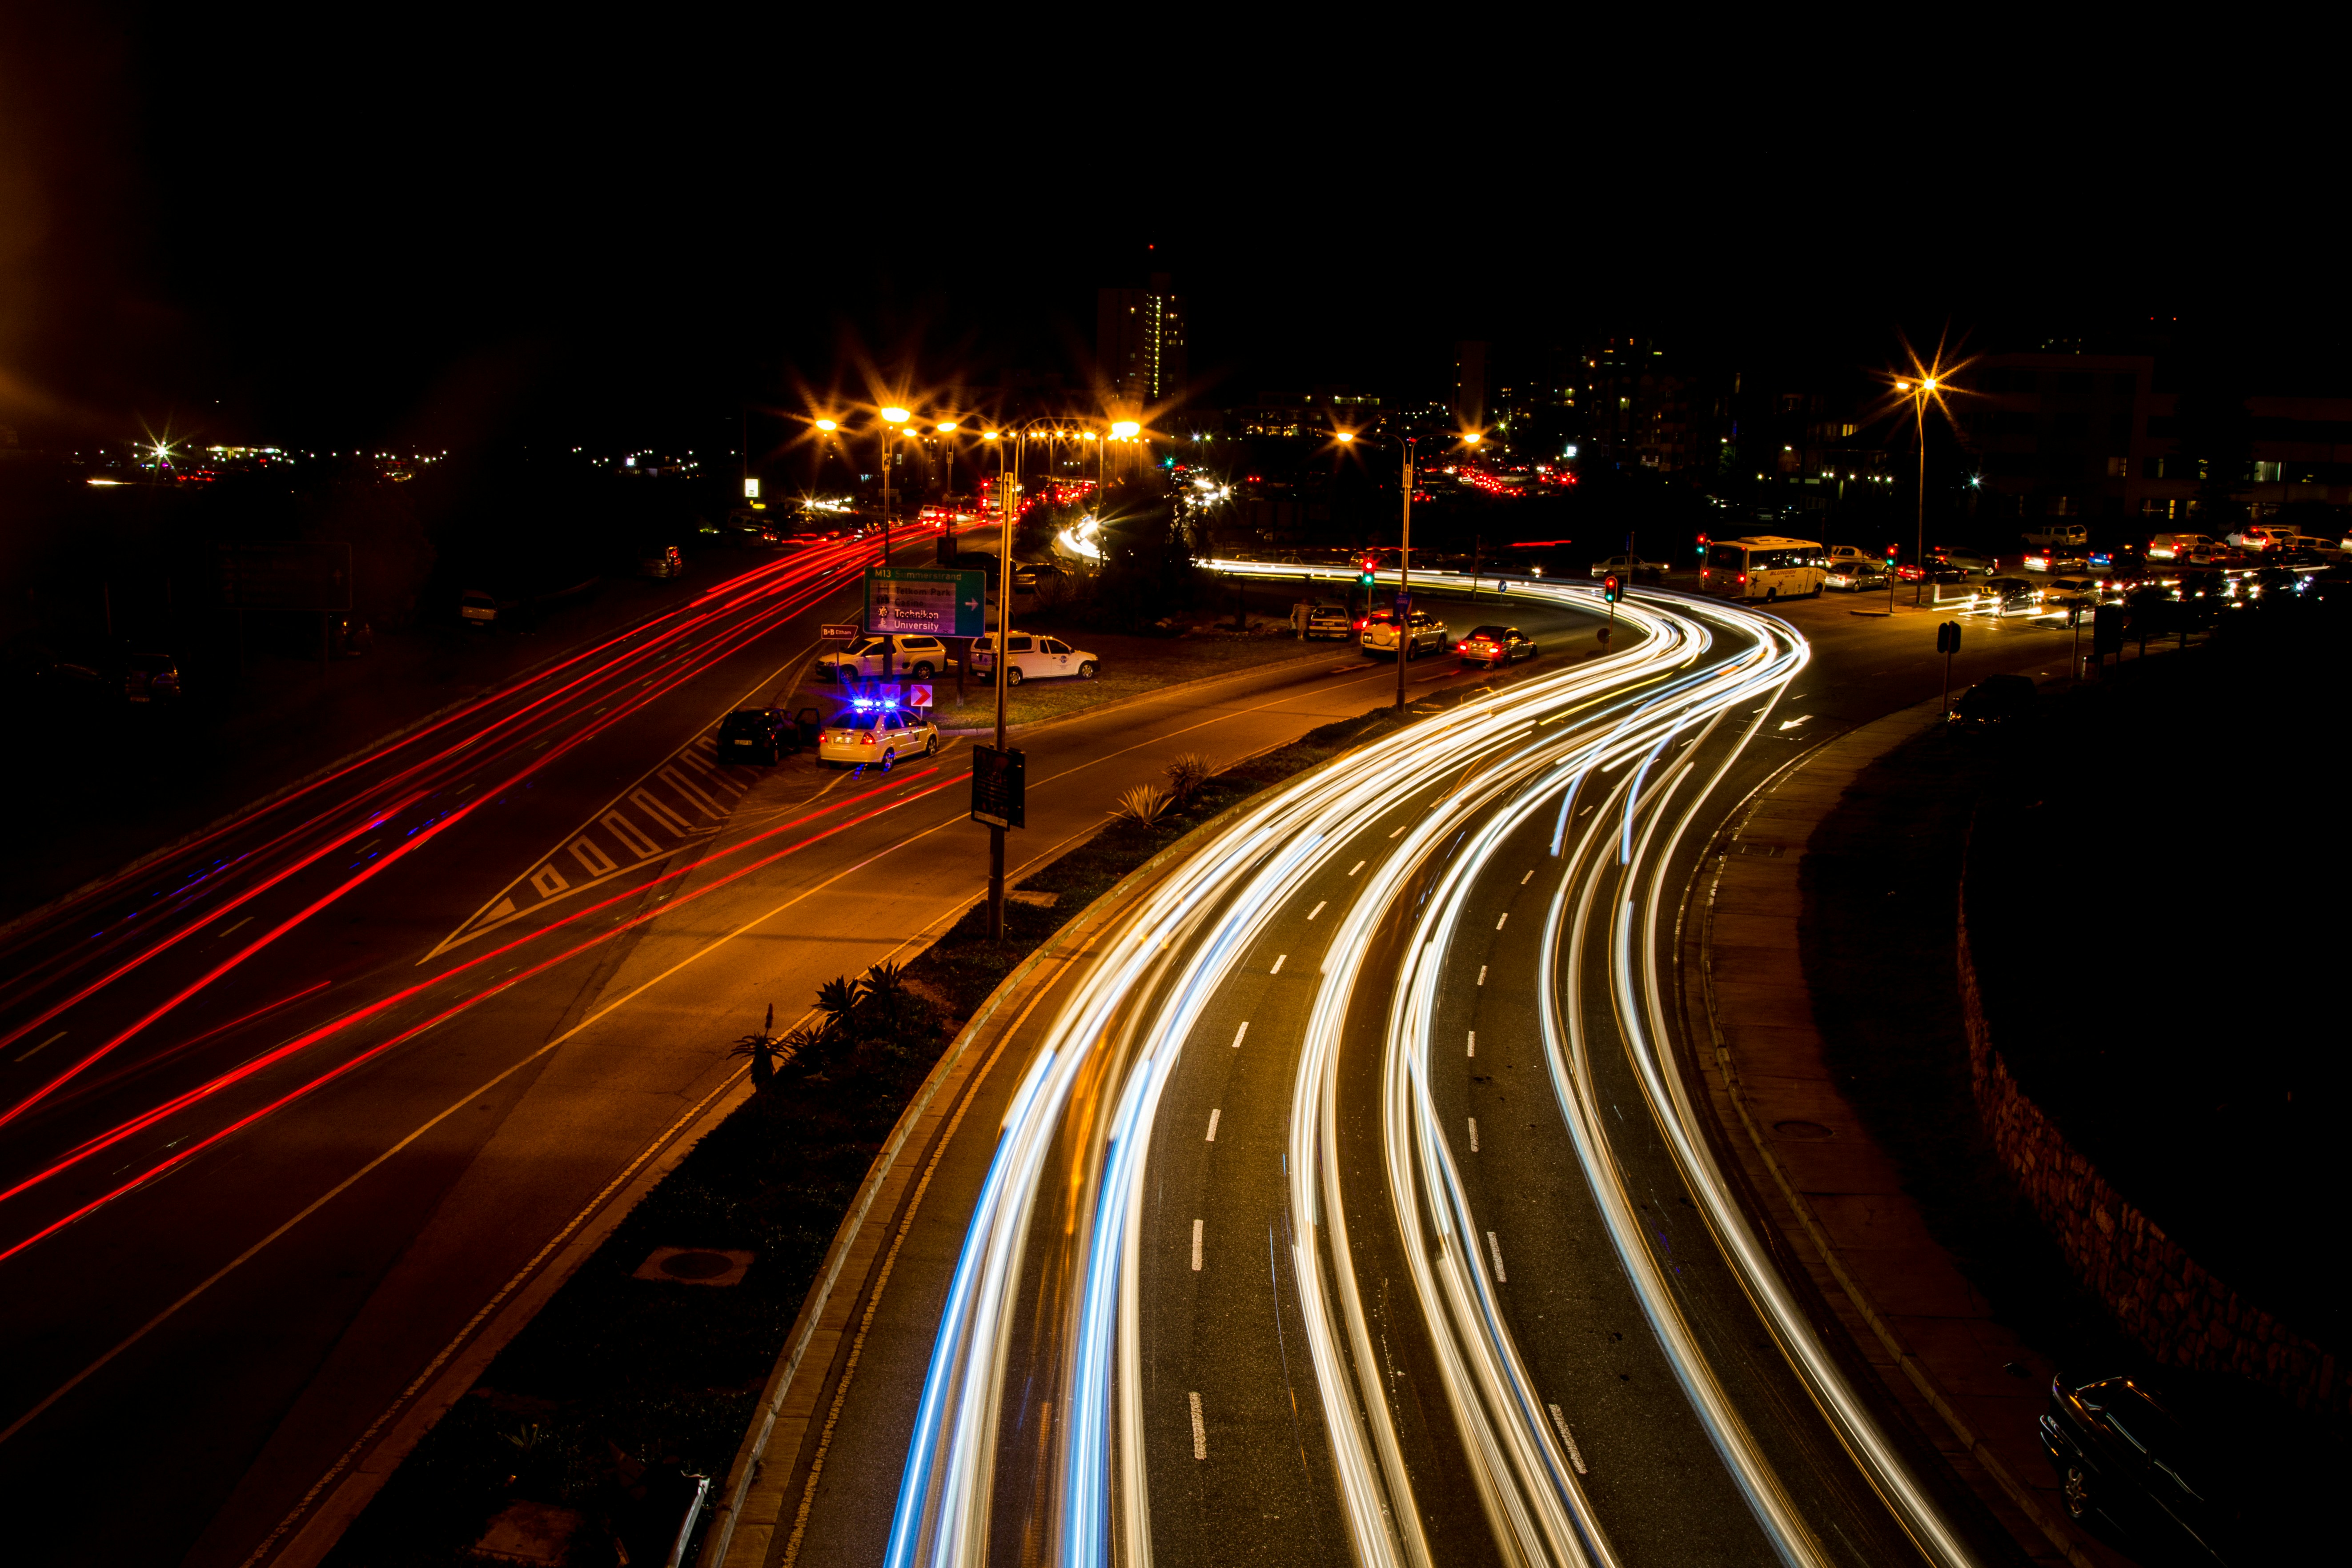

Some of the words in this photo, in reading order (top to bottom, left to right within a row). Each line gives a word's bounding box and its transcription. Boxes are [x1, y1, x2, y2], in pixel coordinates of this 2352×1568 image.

[875, 569, 891, 578] M13
[895, 570, 961, 581] Summerstrand
[895, 587, 927, 595] Telkom
[931, 588, 951, 596] Park
[895, 598, 924, 607] Casino
[895, 620, 939, 630] University
